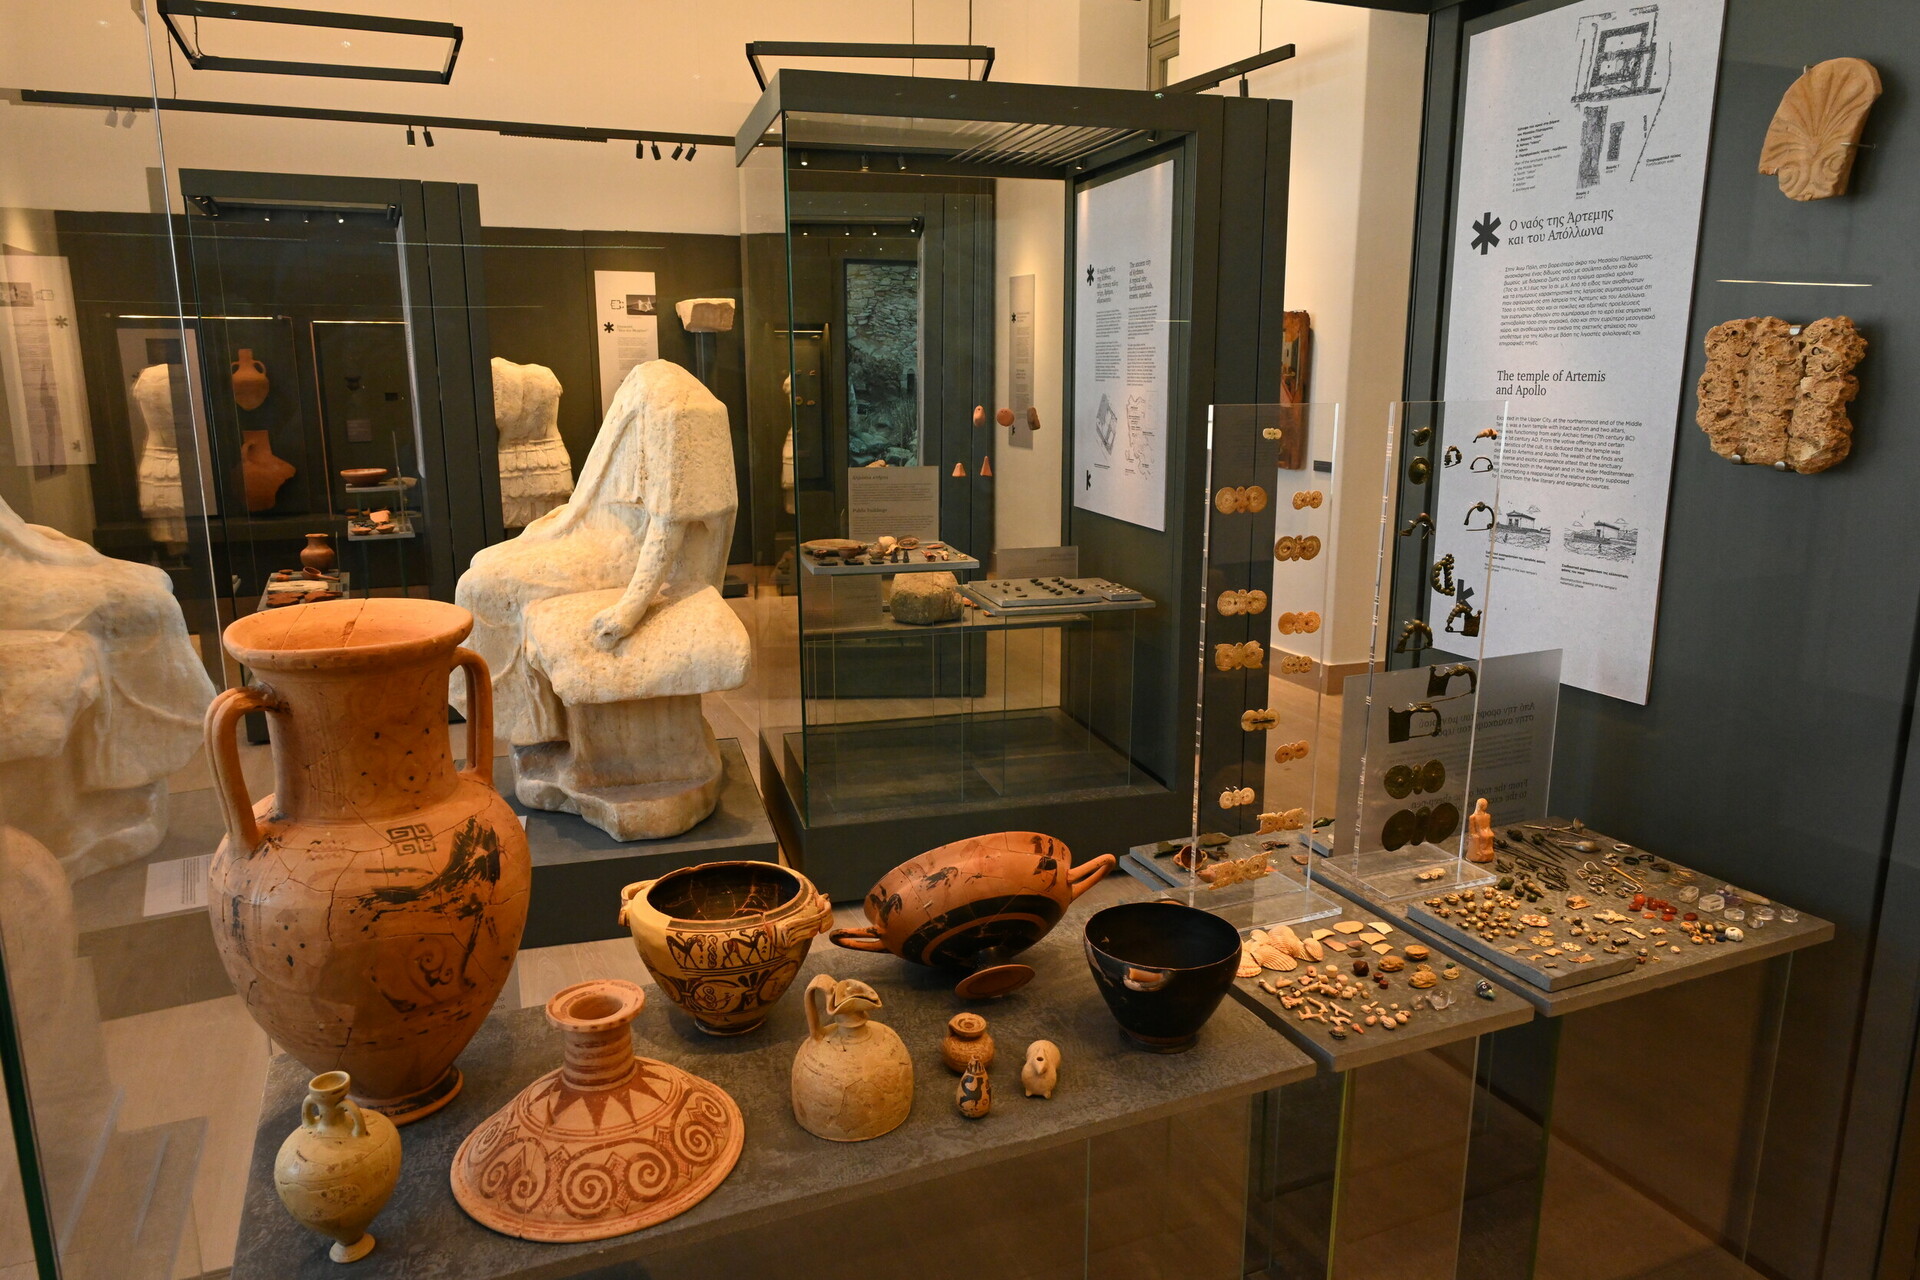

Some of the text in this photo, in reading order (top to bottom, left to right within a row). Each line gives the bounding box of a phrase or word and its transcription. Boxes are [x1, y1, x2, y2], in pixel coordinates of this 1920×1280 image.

[1521, 216, 1544, 229] ναός
[1547, 216, 1564, 227] της
[1567, 209, 1614, 225] Άρτεμης
[1508, 226, 1604, 245] και του Απόλλωνα
[1497, 370, 1605, 384] The temple of Artemis
[1496, 384, 1546, 398] and Apollo
